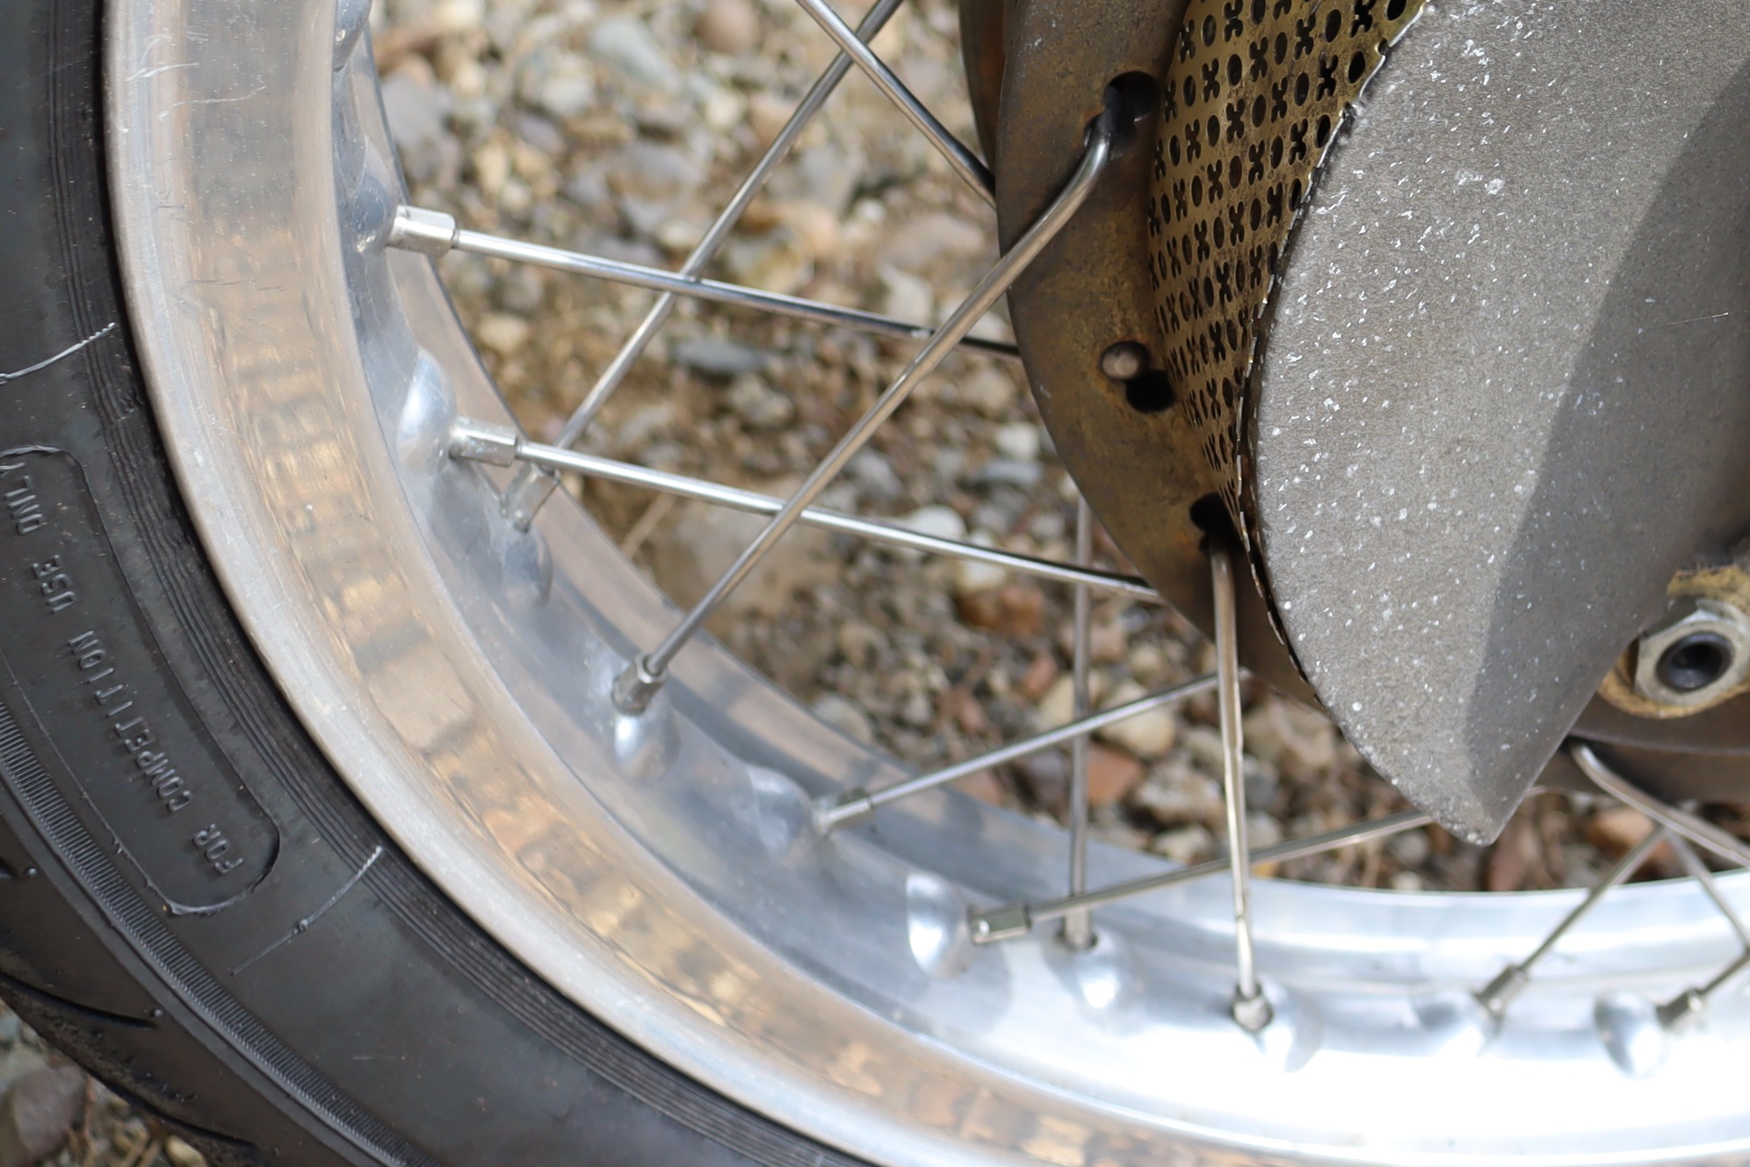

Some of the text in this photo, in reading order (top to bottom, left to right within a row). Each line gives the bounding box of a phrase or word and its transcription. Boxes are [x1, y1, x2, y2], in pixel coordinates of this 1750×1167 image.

[31, 554, 77, 615] USE
[66, 630, 194, 815] COMPETITION
[191, 822, 244, 878] FOR
